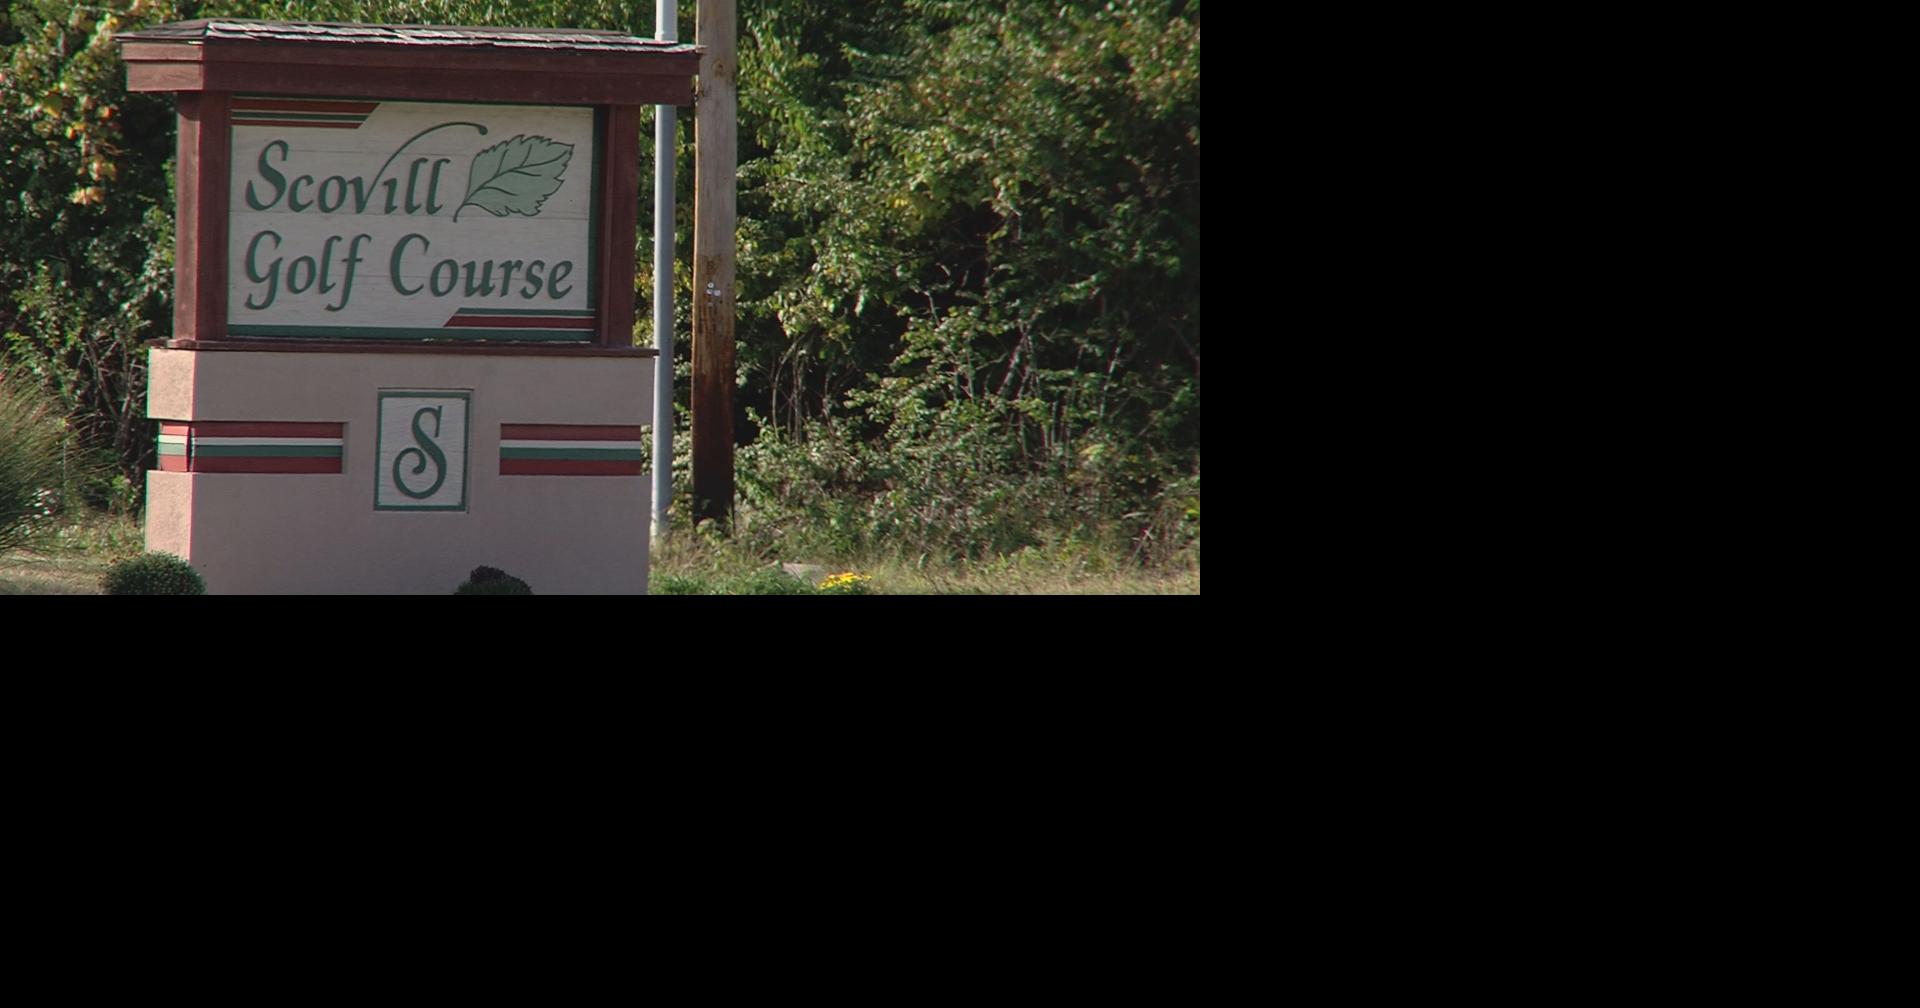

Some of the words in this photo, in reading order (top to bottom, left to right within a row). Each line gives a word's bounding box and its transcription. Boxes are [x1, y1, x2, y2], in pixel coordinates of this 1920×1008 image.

[245, 121, 488, 217] Scovill
[244, 230, 372, 313] Golf
[389, 232, 574, 300] Course
[392, 404, 446, 500] S
